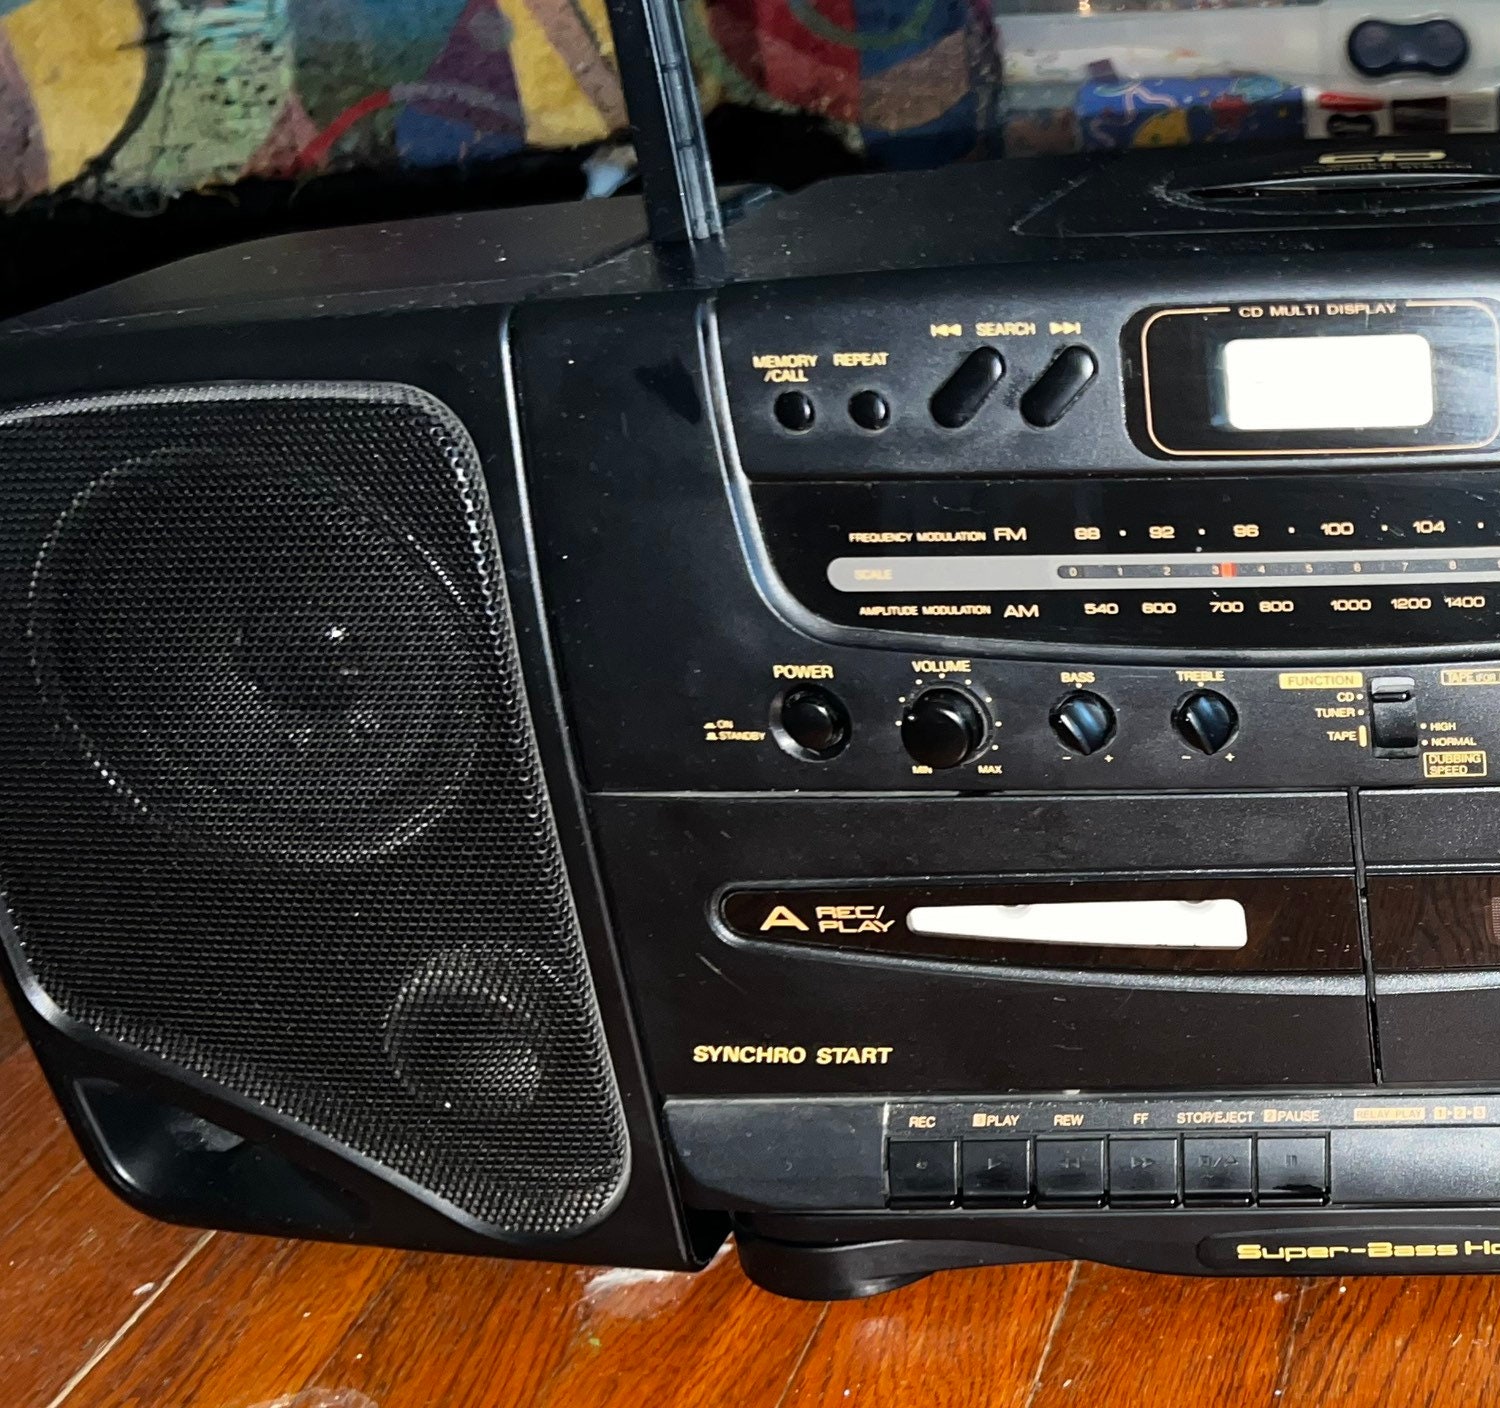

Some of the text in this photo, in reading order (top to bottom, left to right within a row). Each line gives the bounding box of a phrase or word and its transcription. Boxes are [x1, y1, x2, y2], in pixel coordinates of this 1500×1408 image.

[1238, 302, 1397, 319] CD MULTI DISPLAY
[975, 323, 1036, 336] SEARCH
[752, 354, 818, 369] MEMORY
[833, 351, 889, 367] REPEAT
[763, 369, 809, 384] /CALL
[849, 531, 913, 543] FREQUENCY
[916, 531, 987, 542] MODULATION
[993, 527, 1027, 541] FM
[1074, 527, 1101, 540] 88
[1149, 525, 1176, 539] 92
[1233, 524, 1260, 538] 96
[1320, 521, 1355, 536] 100
[1412, 519, 1446, 534] 104
[854, 569, 893, 581] SCALE
[1068, 567, 1079, 577] 0
[1117, 567, 1124, 577] 1
[1163, 566, 1171, 576] 2
[1211, 565, 1220, 576] 3
[1257, 564, 1266, 575] 4
[1305, 563, 1314, 574] 5
[1353, 561, 1363, 573] 6
[1402, 561, 1410, 572] 7
[859, 606, 918, 616] AMPLITUDE
[922, 605, 992, 616] MODULATION
[1003, 604, 1040, 618] AM
[1084, 603, 1119, 615] 540
[1142, 603, 1177, 614] 600
[1209, 602, 1244, 613] 700
[1330, 599, 1372, 611] 1000
[1390, 598, 1432, 610] 1200
[1444, 596, 1486, 608] 1400
[772, 664, 834, 679] POWER
[912, 660, 972, 673] VOLUME
[1060, 671, 1095, 684] BASS
[1176, 670, 1225, 683] TREBLE
[1287, 676, 1354, 687] FUNCTION
[1446, 671, 1473, 683] TAPE
[1337, 692, 1355, 702] CD
[1315, 707, 1356, 717] TUNER
[716, 720, 734, 729] ON
[1430, 722, 1457, 731] HIGH
[719, 731, 766, 741] STANDBY
[1327, 731, 1357, 741] TAPE
[1431, 737, 1477, 747] NORMAL
[1429, 753, 1482, 764] DUBBING
[977, 765, 1003, 774] MAX
[1429, 765, 1468, 775] SPEED
[760, 906, 810, 931] A
[815, 906, 885, 919] REC/
[819, 920, 895, 933] PLAY
[693, 1045, 894, 1064] SYNCHRO START
[986, 1114, 1020, 1127] PLAY
[1054, 1114, 1084, 1126] REW
[1133, 1113, 1149, 1125] FF
[1176, 1111, 1255, 1125] STOP/EJECT
[1277, 1110, 1320, 1122] PAUSE
[1356, 1110, 1390, 1119] RELAY
[1395, 1109, 1423, 1118] PLAY
[908, 1116, 936, 1128] REC
[1237, 1242, 1458, 1262] Super-Bass
